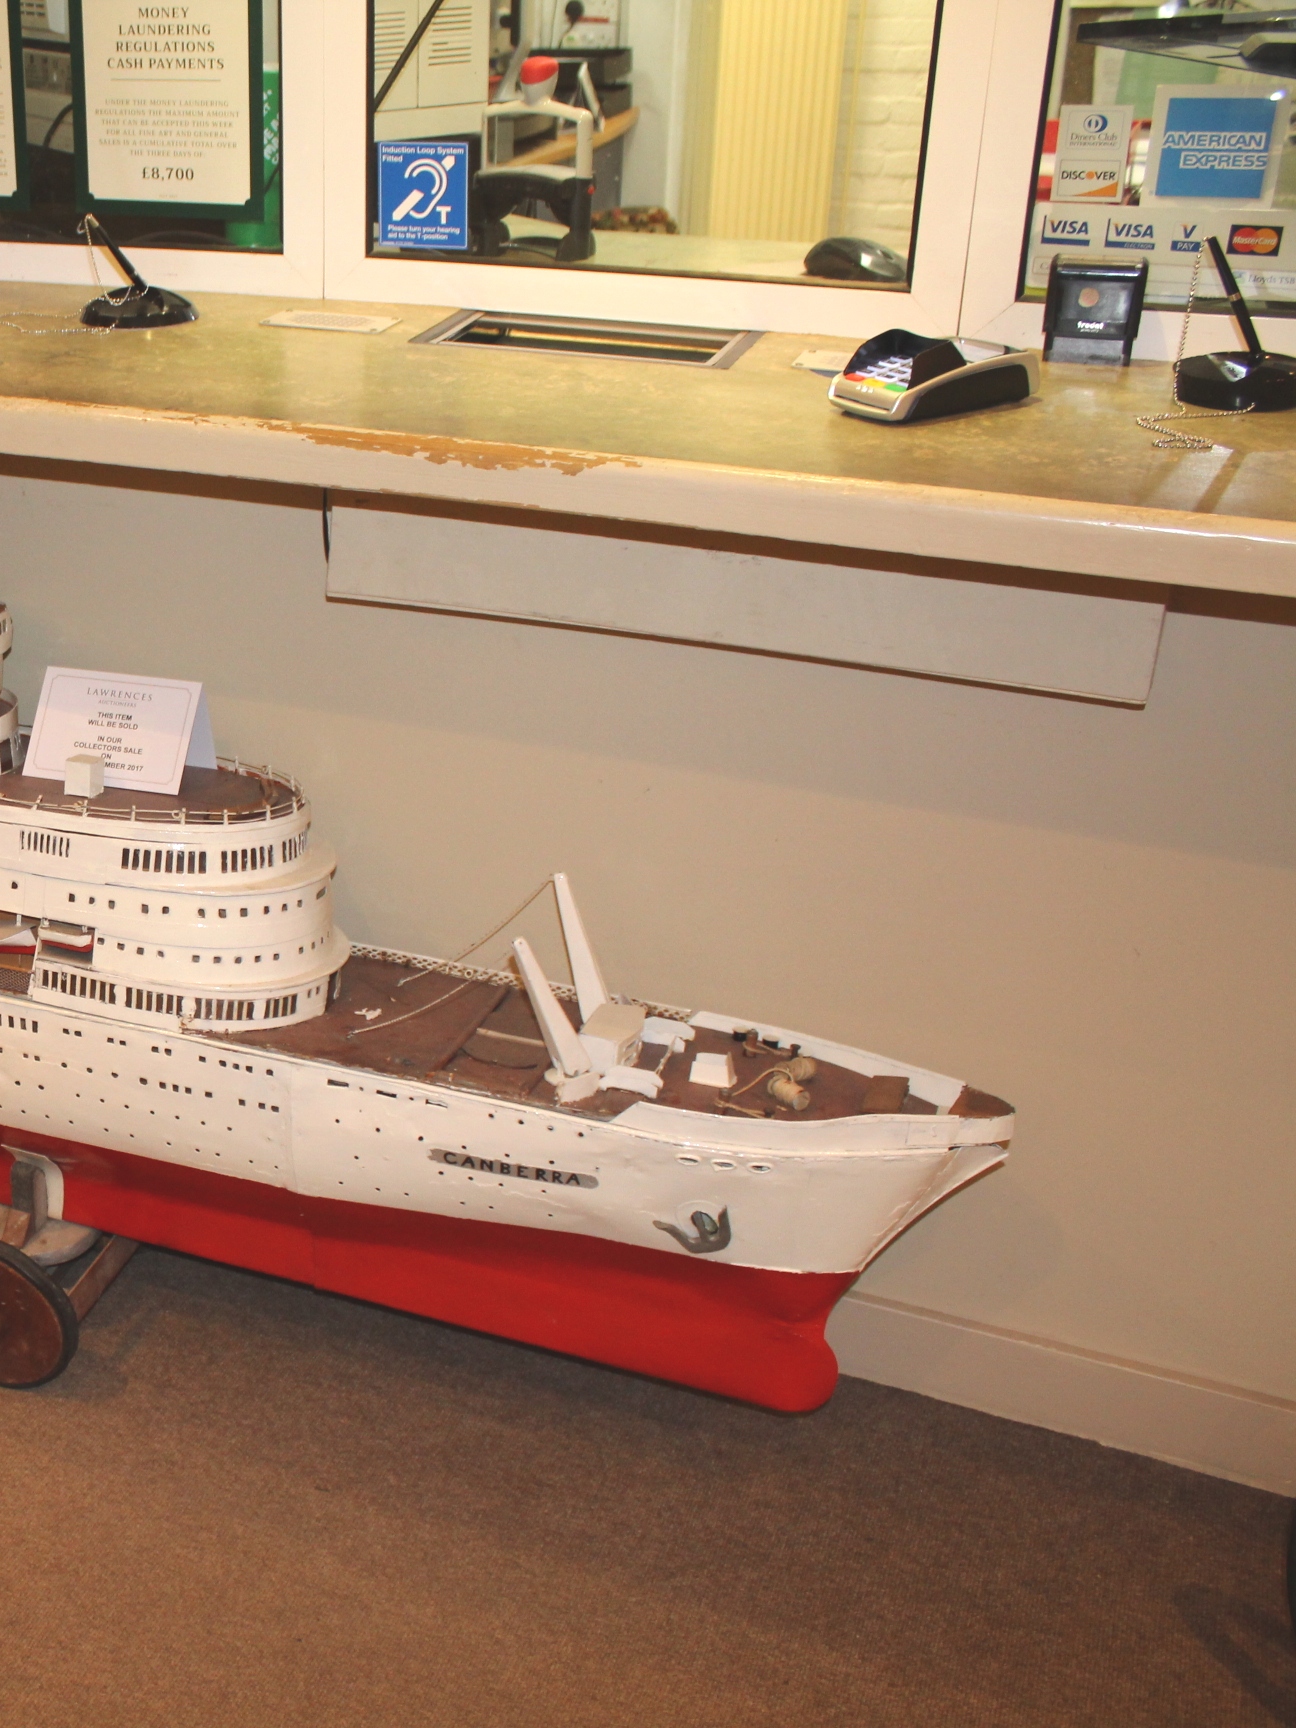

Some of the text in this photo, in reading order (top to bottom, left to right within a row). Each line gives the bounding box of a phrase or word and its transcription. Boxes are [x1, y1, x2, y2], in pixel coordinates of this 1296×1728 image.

[138, 7, 190, 19] MONEY
[118, 24, 211, 36] LAUNDERING
[116, 41, 216, 52] REGULATIONS
[107, 57, 225, 70] CASH PAYMENTS
[1098, 132, 1118, 140] Club
[1163, 132, 1266, 150] AMERICAN
[382, 146, 464, 155] Induction Loop System
[1180, 152, 1268, 170] EXPRESS
[142, 166, 194, 180] £8,700
[1061, 170, 1117, 180] DISCOVER
[436, 206, 452, 224] T
[437, 226, 460, 234] hearing
[1050, 220, 1089, 235] VISA
[1113, 222, 1154, 238] VISA
[1181, 224, 1198, 239] V
[1176, 242, 1194, 250] PAY
[1232, 236, 1278, 245] MasterCard
[1248, 274, 1296, 284] Lloyds TSB
[87, 687, 153, 702] LAWRENCES
[98, 700, 137, 708] AUCTIONEERS
[98, 712, 133, 721] THIS ITEM
[88, 719, 105, 727] WILL
[118, 722, 138, 730] SOLD
[106, 736, 122, 744] OUR
[74, 741, 143, 755] COLLECTORS SALE
[127, 764, 144, 772] 2017
[443, 1151, 580, 1186] CANBERRA
